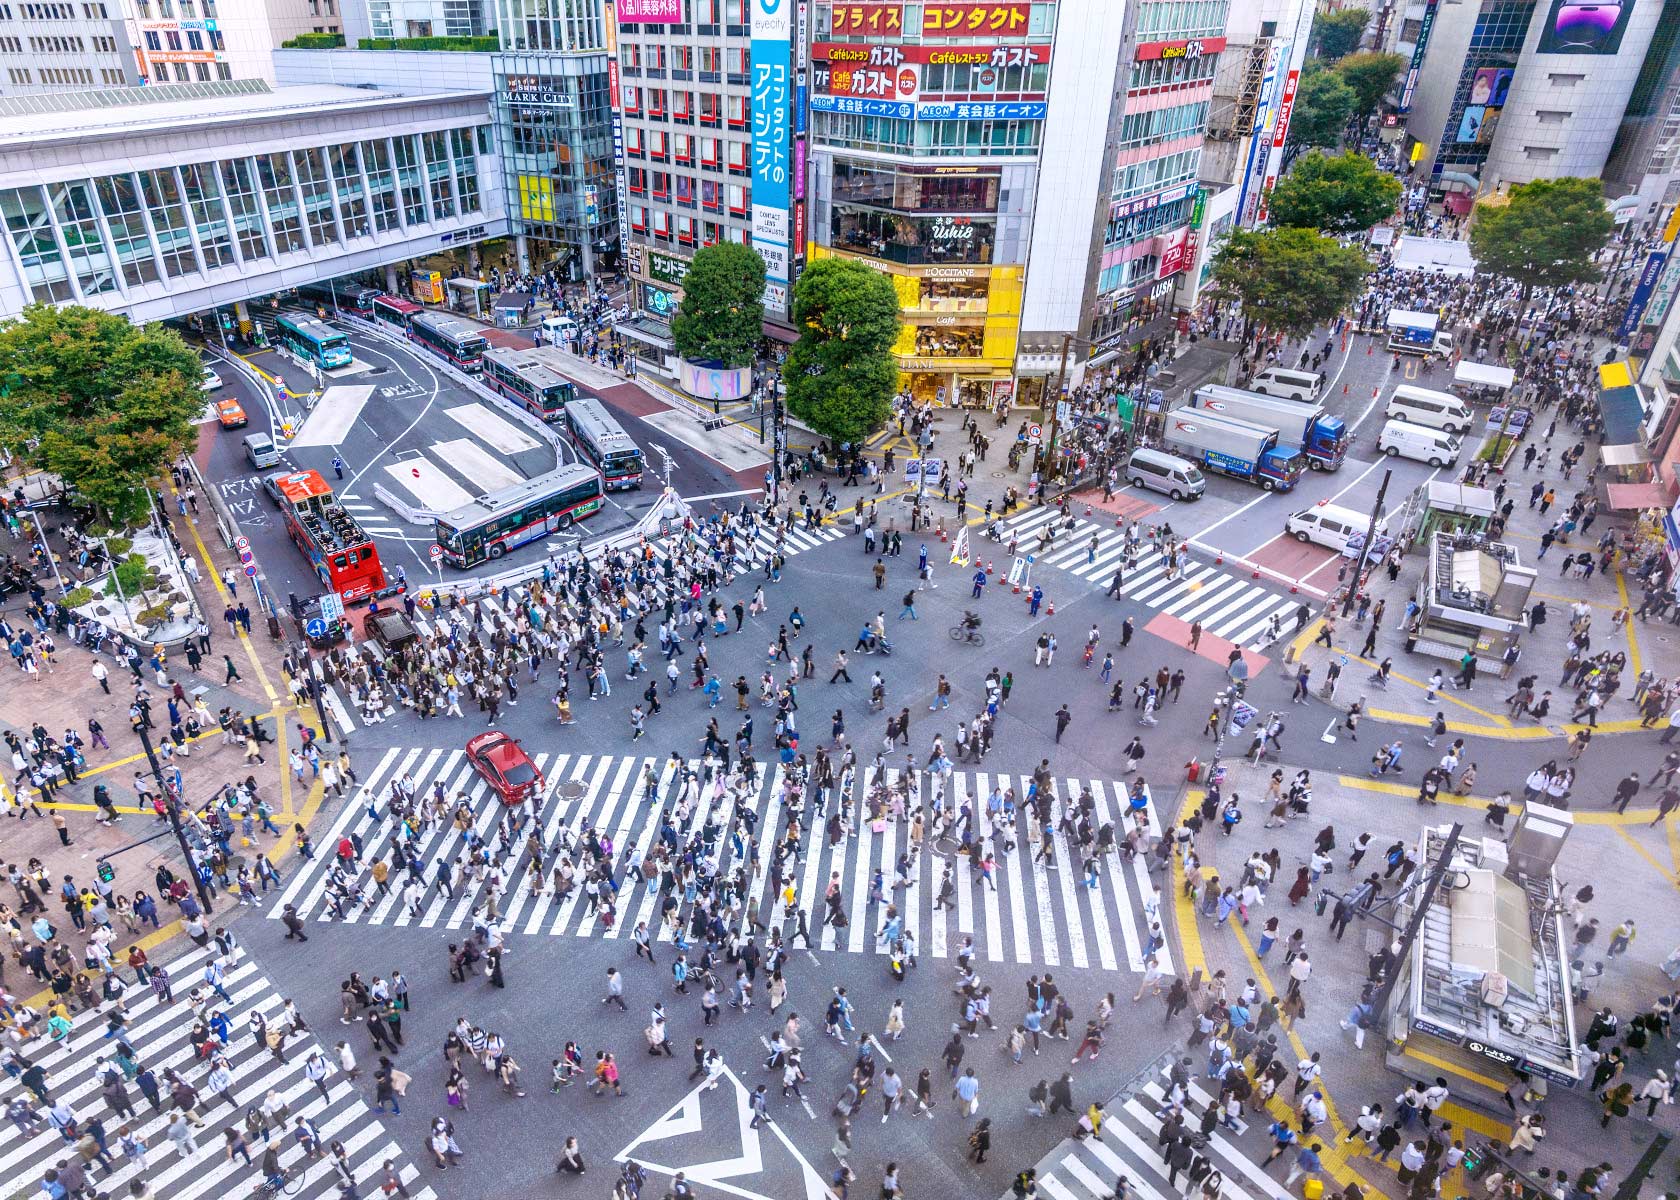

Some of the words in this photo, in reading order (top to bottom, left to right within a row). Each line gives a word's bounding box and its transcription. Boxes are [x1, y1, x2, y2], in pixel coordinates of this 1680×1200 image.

[755, 17, 786, 32] eyecity
[833, 8, 901, 29] プライス
[923, 8, 1026, 30] コンタクト
[870, 45, 905, 66] ガスト
[990, 47, 1039, 67] ガスト
[815, 70, 830, 86] 7F
[851, 67, 894, 95] ガスト
[502, 91, 539, 102] MARK
[543, 93, 573, 104] CITY
[922, 106, 951, 117] AEON
[755, 63, 771, 182] アイシティ
[772, 64, 786, 184] コンタクトの
[925, 267, 975, 279] L'OCCITANE
[1150, 277, 1175, 301] LUSH
[936, 315, 956, 326] Café
